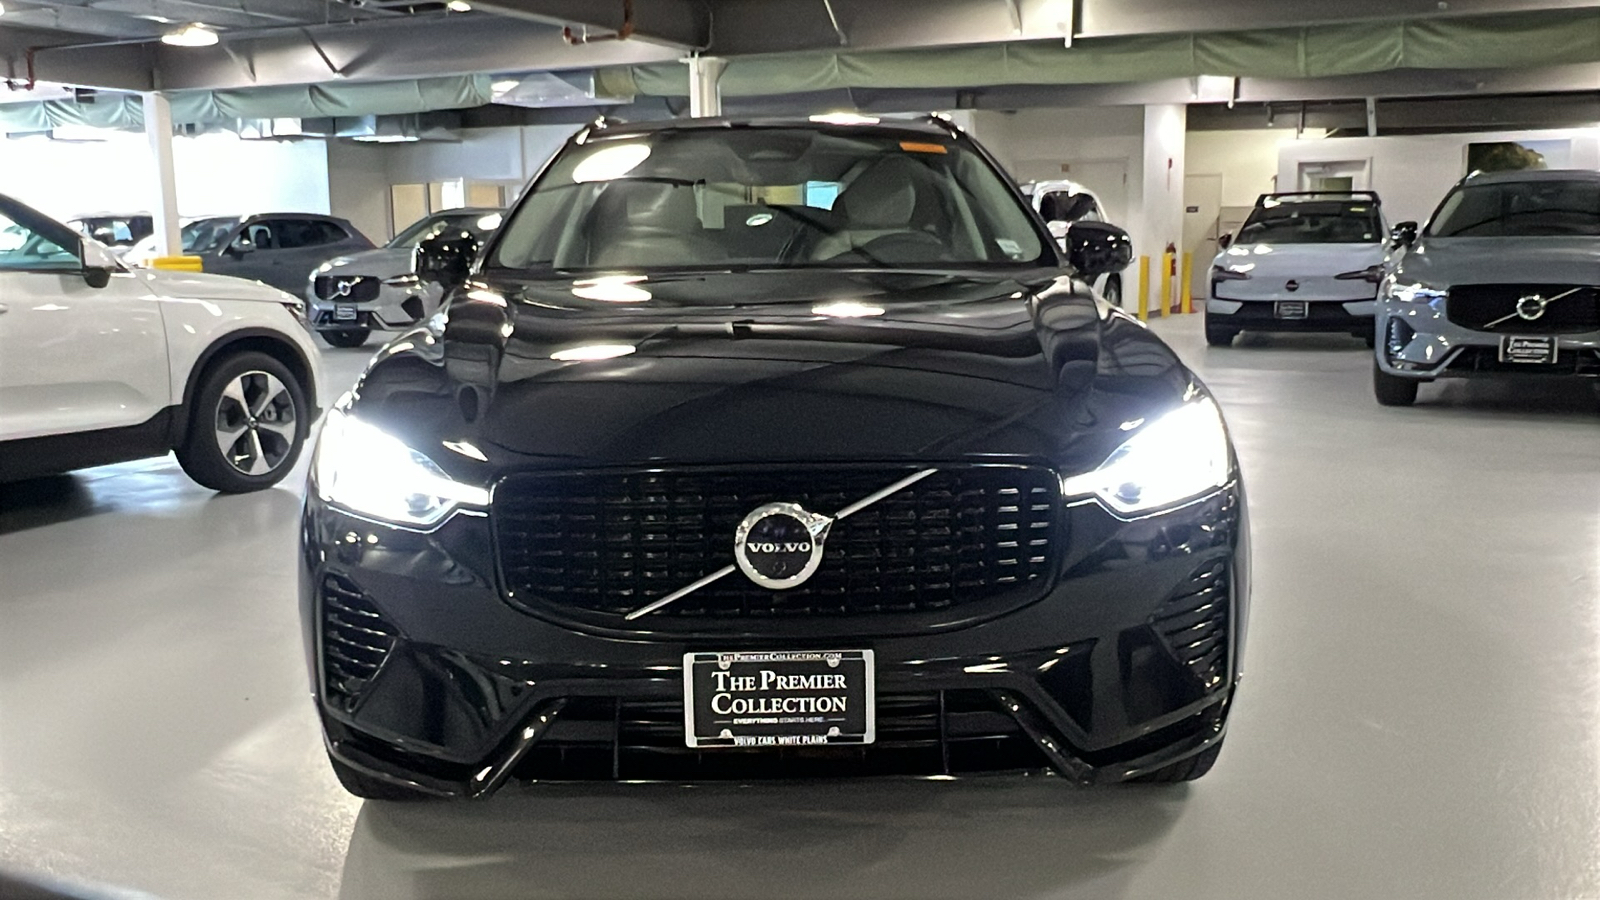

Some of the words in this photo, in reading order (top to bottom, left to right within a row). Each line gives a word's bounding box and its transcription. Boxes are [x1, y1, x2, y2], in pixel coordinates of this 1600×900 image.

[747, 542, 811, 553] VOLVO
[711, 671, 756, 691] THE
[760, 670, 847, 691] PREMIER
[711, 692, 847, 714] COLLECTION
[734, 737, 756, 746] VOLVO
[758, 736, 776, 745] CARS
[778, 736, 801, 744] WHITE
[803, 735, 828, 744] PLAINS
